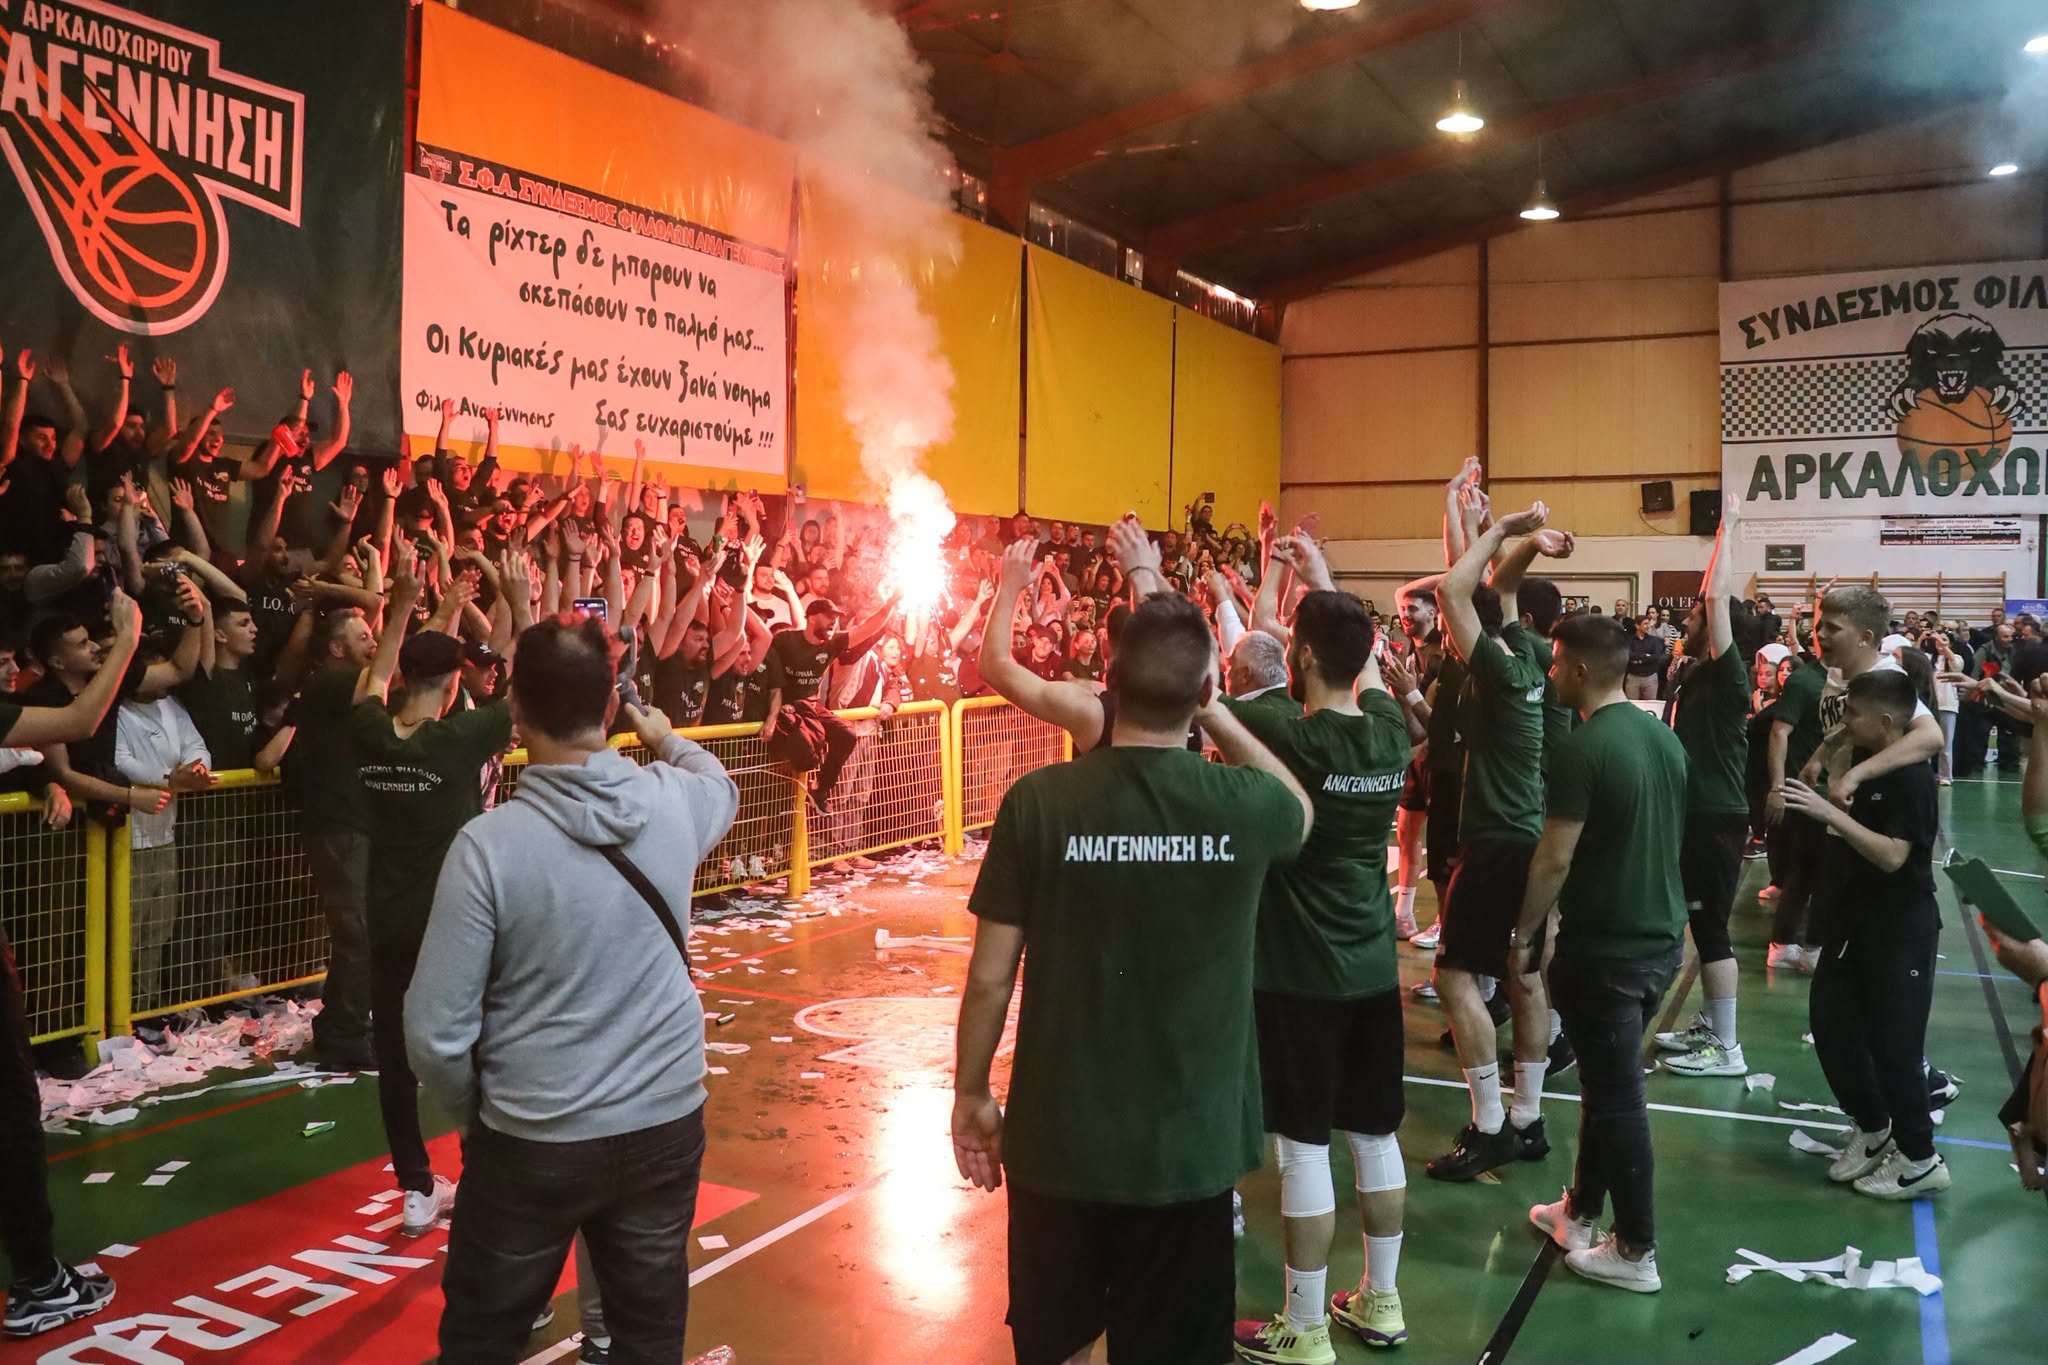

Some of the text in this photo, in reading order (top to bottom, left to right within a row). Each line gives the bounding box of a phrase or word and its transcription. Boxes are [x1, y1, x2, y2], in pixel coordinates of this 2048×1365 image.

[23, 0, 192, 76] ΑΡΚΑΛΟΧΩΡΙΟΥ
[519, 176, 618, 227] ΣΥΝΔΕΣΜΟΣ
[440, 200, 717, 302] Τα ρίχτερ δε μπορουν να
[519, 282, 628, 322] σκεπάσουν
[635, 306, 657, 328] το
[664, 312, 719, 351] παλμό
[1738, 276, 1961, 350] ΣΥΝΔΕΣΜΟΣ
[426, 323, 449, 355] Οι
[458, 326, 565, 387] Κυριακές
[570, 357, 609, 390] μας
[617, 355, 671, 391] έχουν
[678, 360, 718, 403] ξανά
[460, 396, 555, 429] Αναέννησης
[595, 399, 630, 432] Σας
[636, 413, 754, 456] ευχαριστούμε
[1745, 446, 2048, 501] ΑΡΚΑΛΟΧΩ
[1322, 769, 1406, 793] ΑΝΑΓΕΝΝΗΣΗ B.C
[1064, 834, 1236, 862] ΑΝΑΓΕΝΝΗΣΗ B.C.
